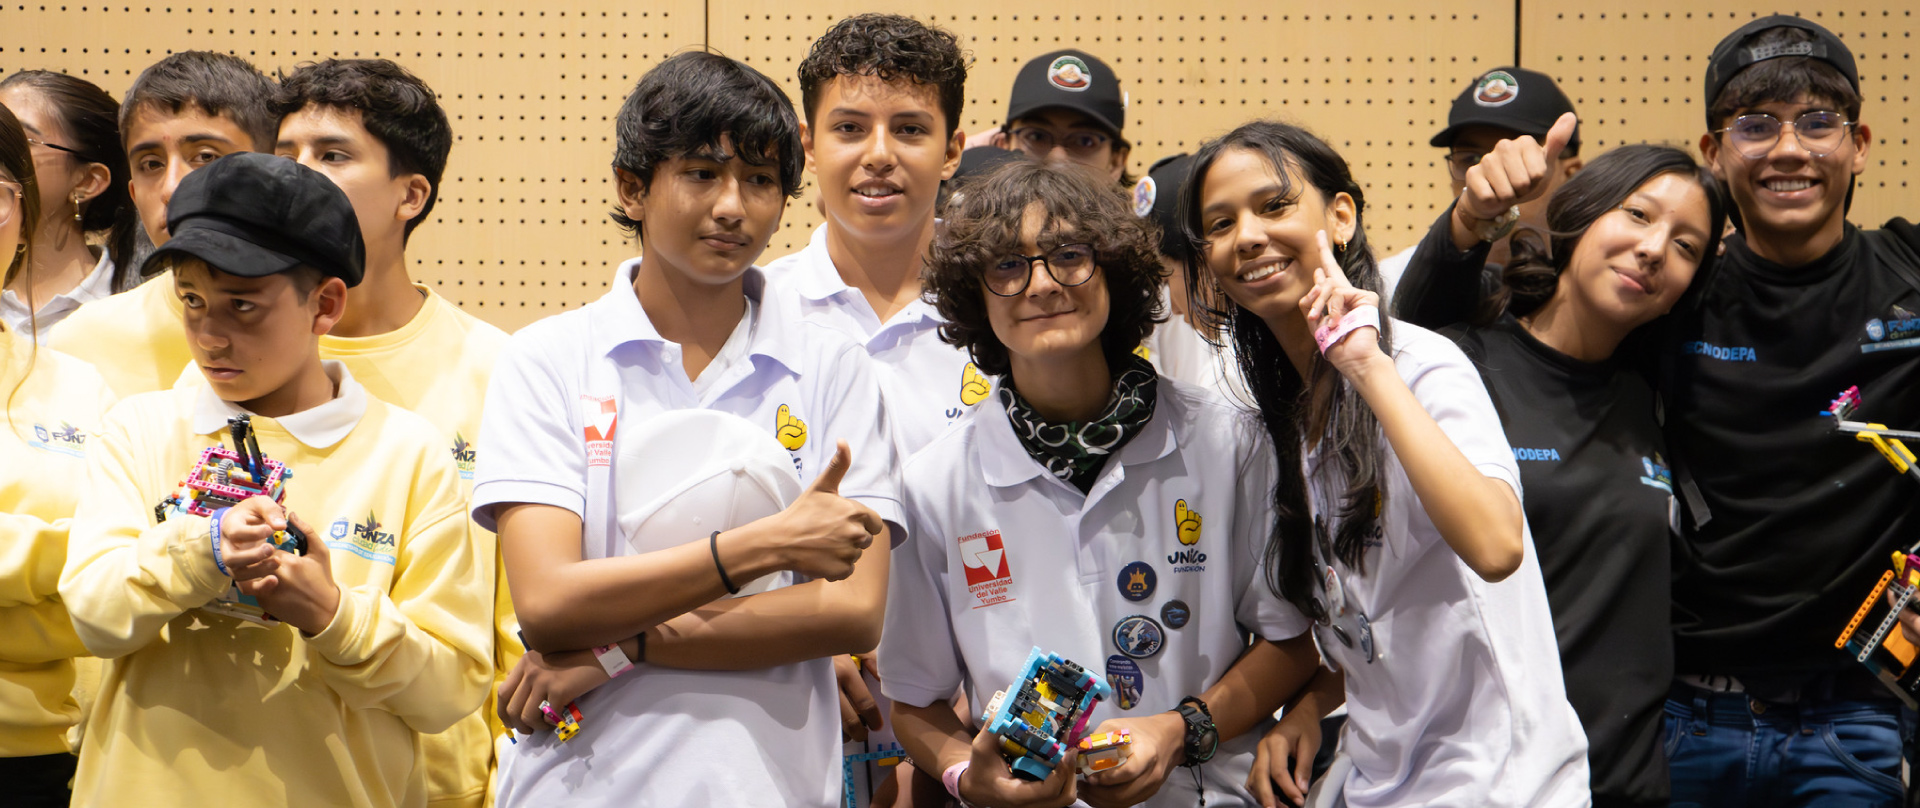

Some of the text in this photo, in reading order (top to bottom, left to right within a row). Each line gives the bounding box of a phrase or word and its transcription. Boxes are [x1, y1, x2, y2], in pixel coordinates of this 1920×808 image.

[353, 523, 395, 547] FUNZA
[957, 528, 1001, 543] Fundación
[968, 577, 1013, 594] Universidad
[976, 586, 1008, 599] del Valle
[980, 595, 1007, 605] Yumbo
